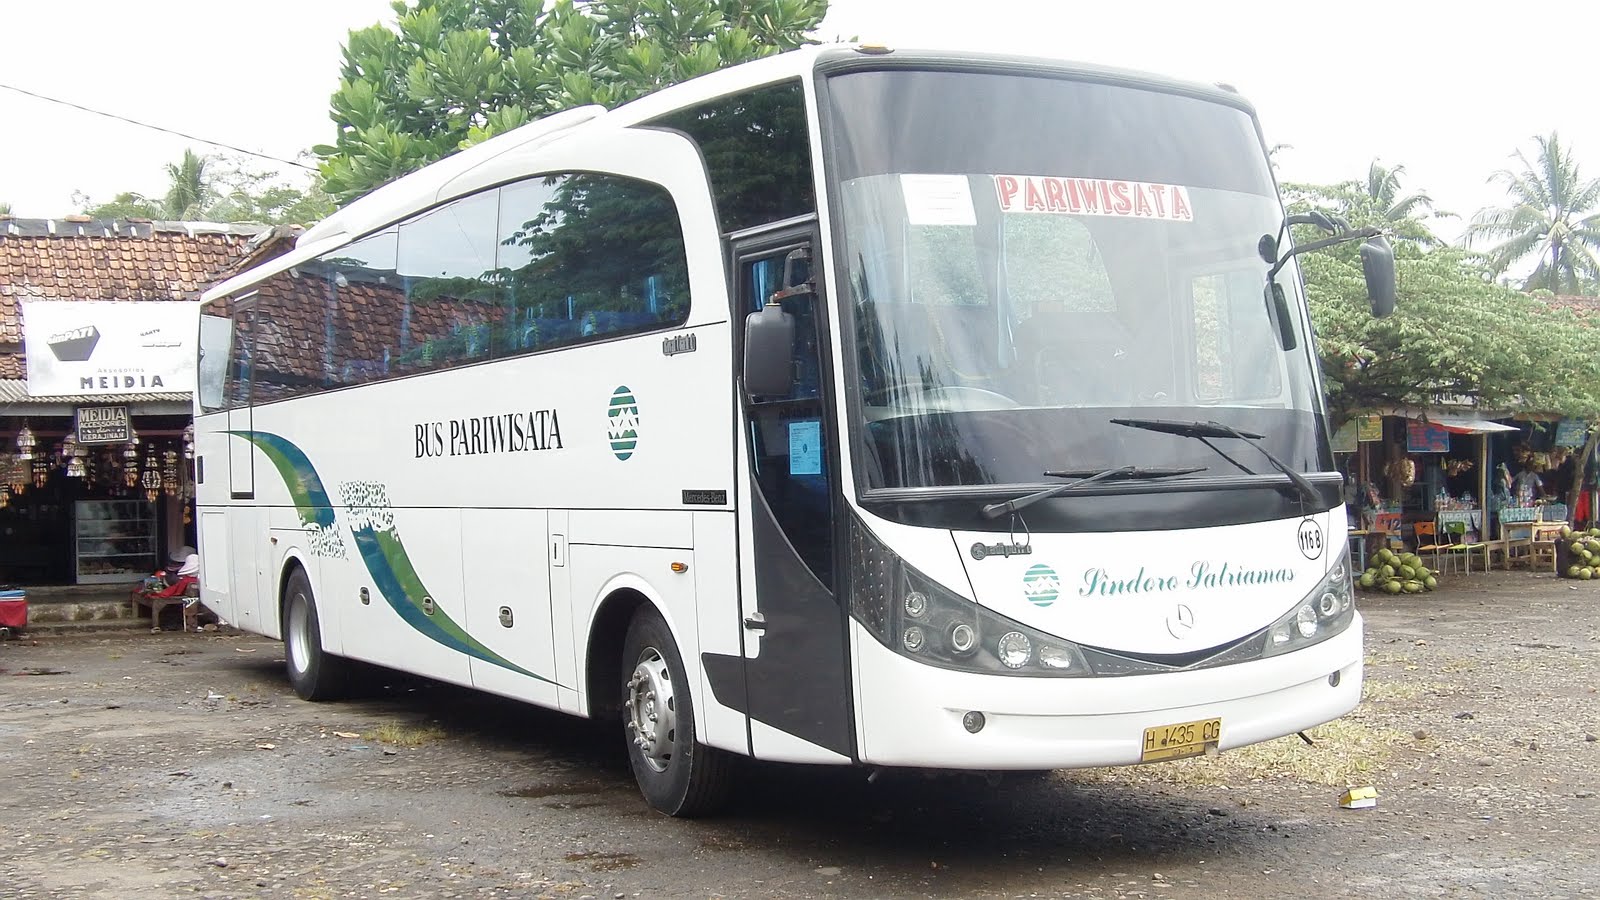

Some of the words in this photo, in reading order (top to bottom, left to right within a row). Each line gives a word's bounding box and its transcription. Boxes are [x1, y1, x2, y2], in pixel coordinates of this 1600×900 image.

[995, 175, 1192, 221] PARIWISATA
[80, 375, 164, 389] MEIDIA
[80, 408, 126, 422] MEIDIA
[415, 422, 444, 458] BUS
[449, 408, 563, 456] PARIWISATA
[1079, 566, 1178, 597] Sindoro
[1145, 730, 1156, 750] H
[1161, 723, 1195, 747] 1435
[1202, 720, 1220, 740] CG
